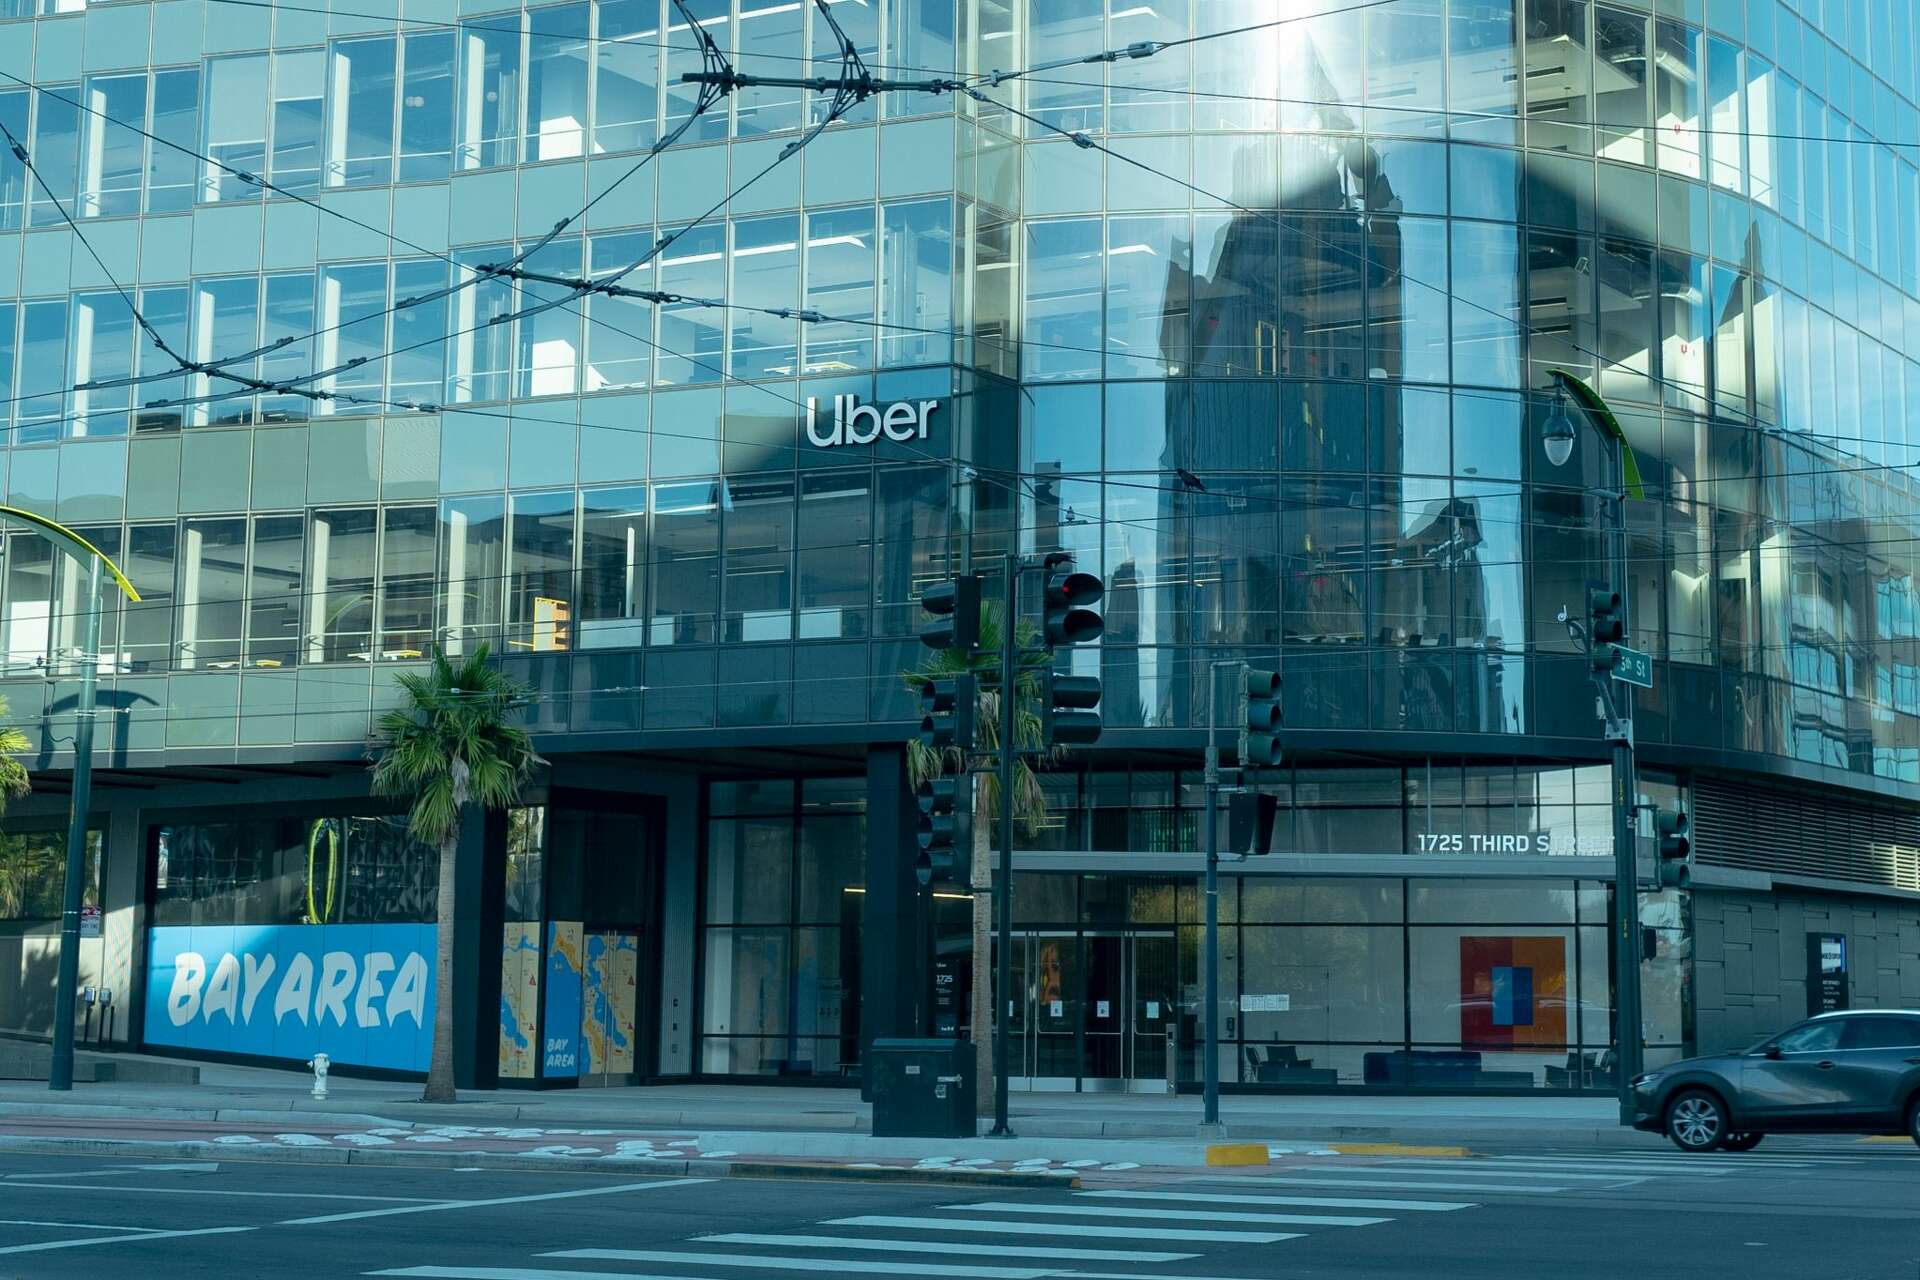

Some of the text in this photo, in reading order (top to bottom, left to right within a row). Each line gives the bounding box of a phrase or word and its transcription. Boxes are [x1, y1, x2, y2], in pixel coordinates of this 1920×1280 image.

[807, 393, 938, 447] Uber
[1636, 660, 1646, 678] St
[1418, 834, 1463, 851] 1725
[1470, 835, 1530, 852] THIRD
[167, 951, 428, 1030] BAY AREA
[547, 1038, 569, 1053] BAY
[546, 1053, 575, 1068] AREA
